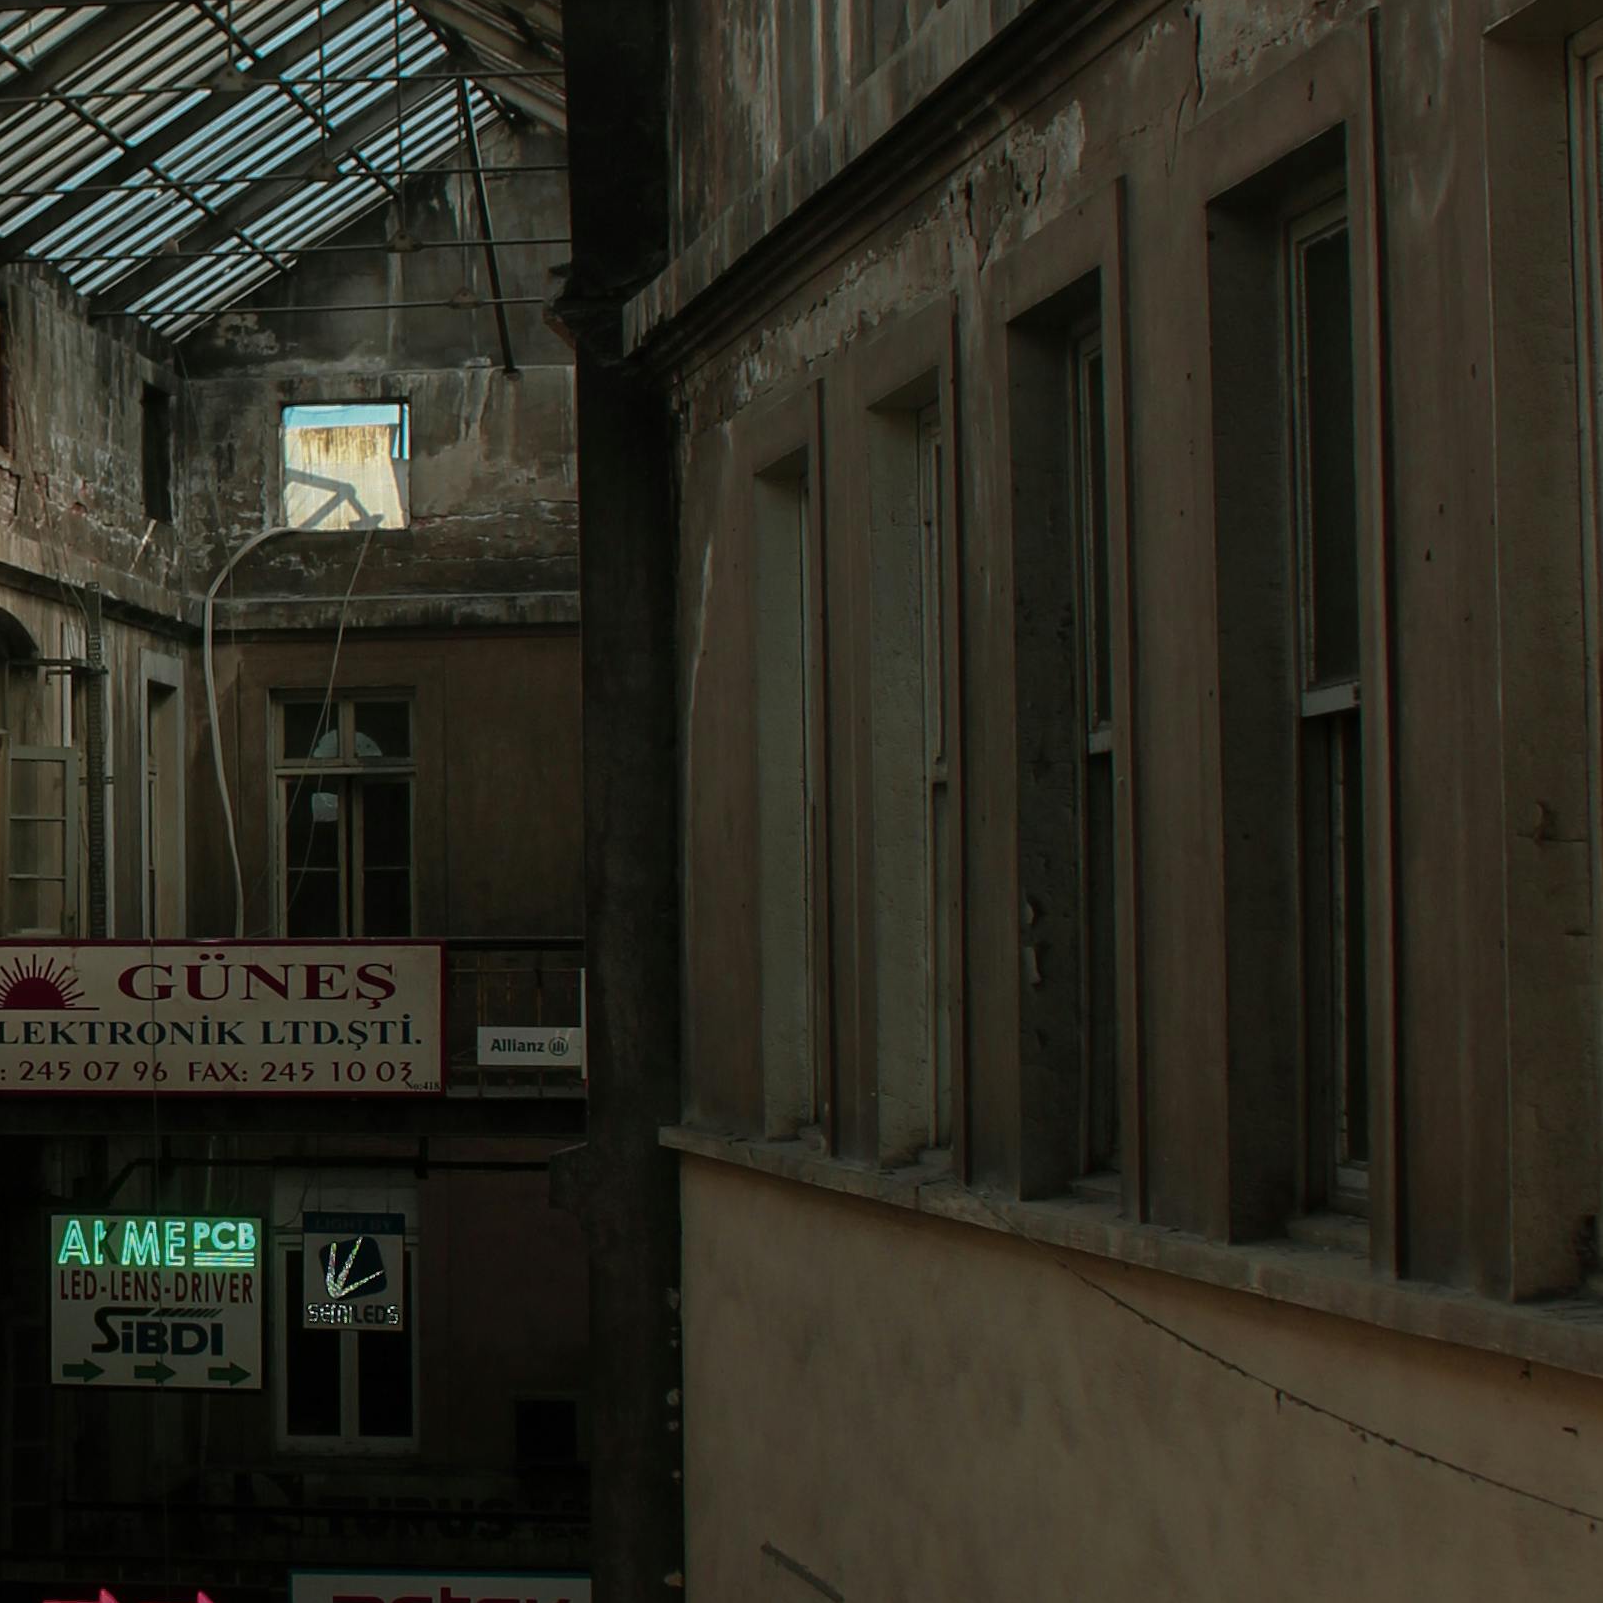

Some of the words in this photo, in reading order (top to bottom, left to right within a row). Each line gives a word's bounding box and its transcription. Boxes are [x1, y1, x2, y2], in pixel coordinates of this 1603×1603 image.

[119, 953, 396, 1009] GÜNEŞ
[491, 1038, 545, 1053] Allianz
[19, 1060, 71, 1082] 245
[84, 1061, 119, 1082] 07
[134, 1061, 168, 1083] 96
[188, 1061, 247, 1082] FAX:
[261, 1061, 315, 1082] 245
[57, 1218, 187, 1267] AKME
[193, 1221, 256, 1251] PCB
